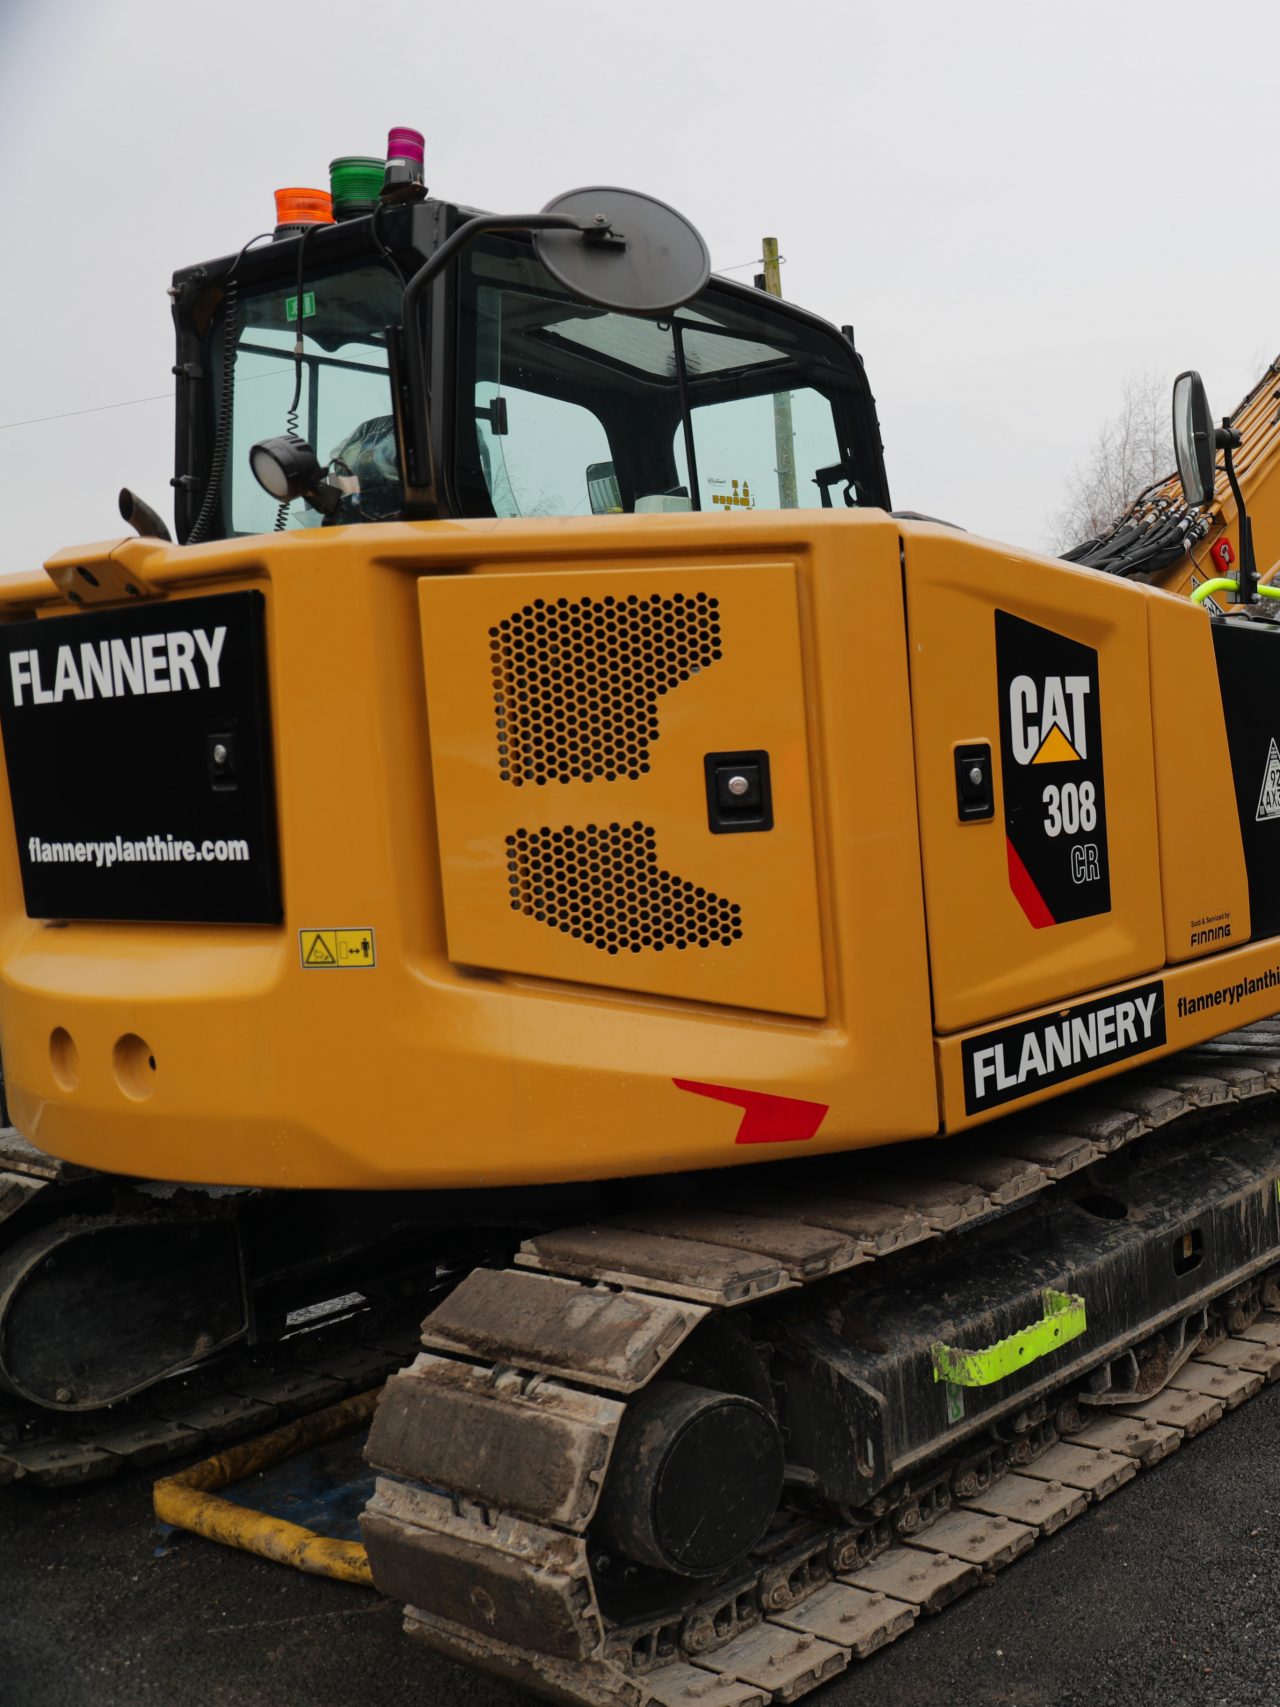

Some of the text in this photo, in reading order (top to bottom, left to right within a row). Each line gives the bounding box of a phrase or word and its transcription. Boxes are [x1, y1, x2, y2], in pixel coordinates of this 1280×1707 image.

[9, 626, 227, 706] FLANNERY
[1009, 675, 1090, 765] CAT
[1270, 769, 1280, 788] 92
[1042, 780, 1097, 837] 308
[28, 834, 250, 867] flanneryplanthire.com
[1071, 843, 1100, 884] CR
[1190, 924, 1231, 947] FINNING
[1191, 920, 1201, 928] Sold
[973, 992, 1157, 1098] FLANNERY
